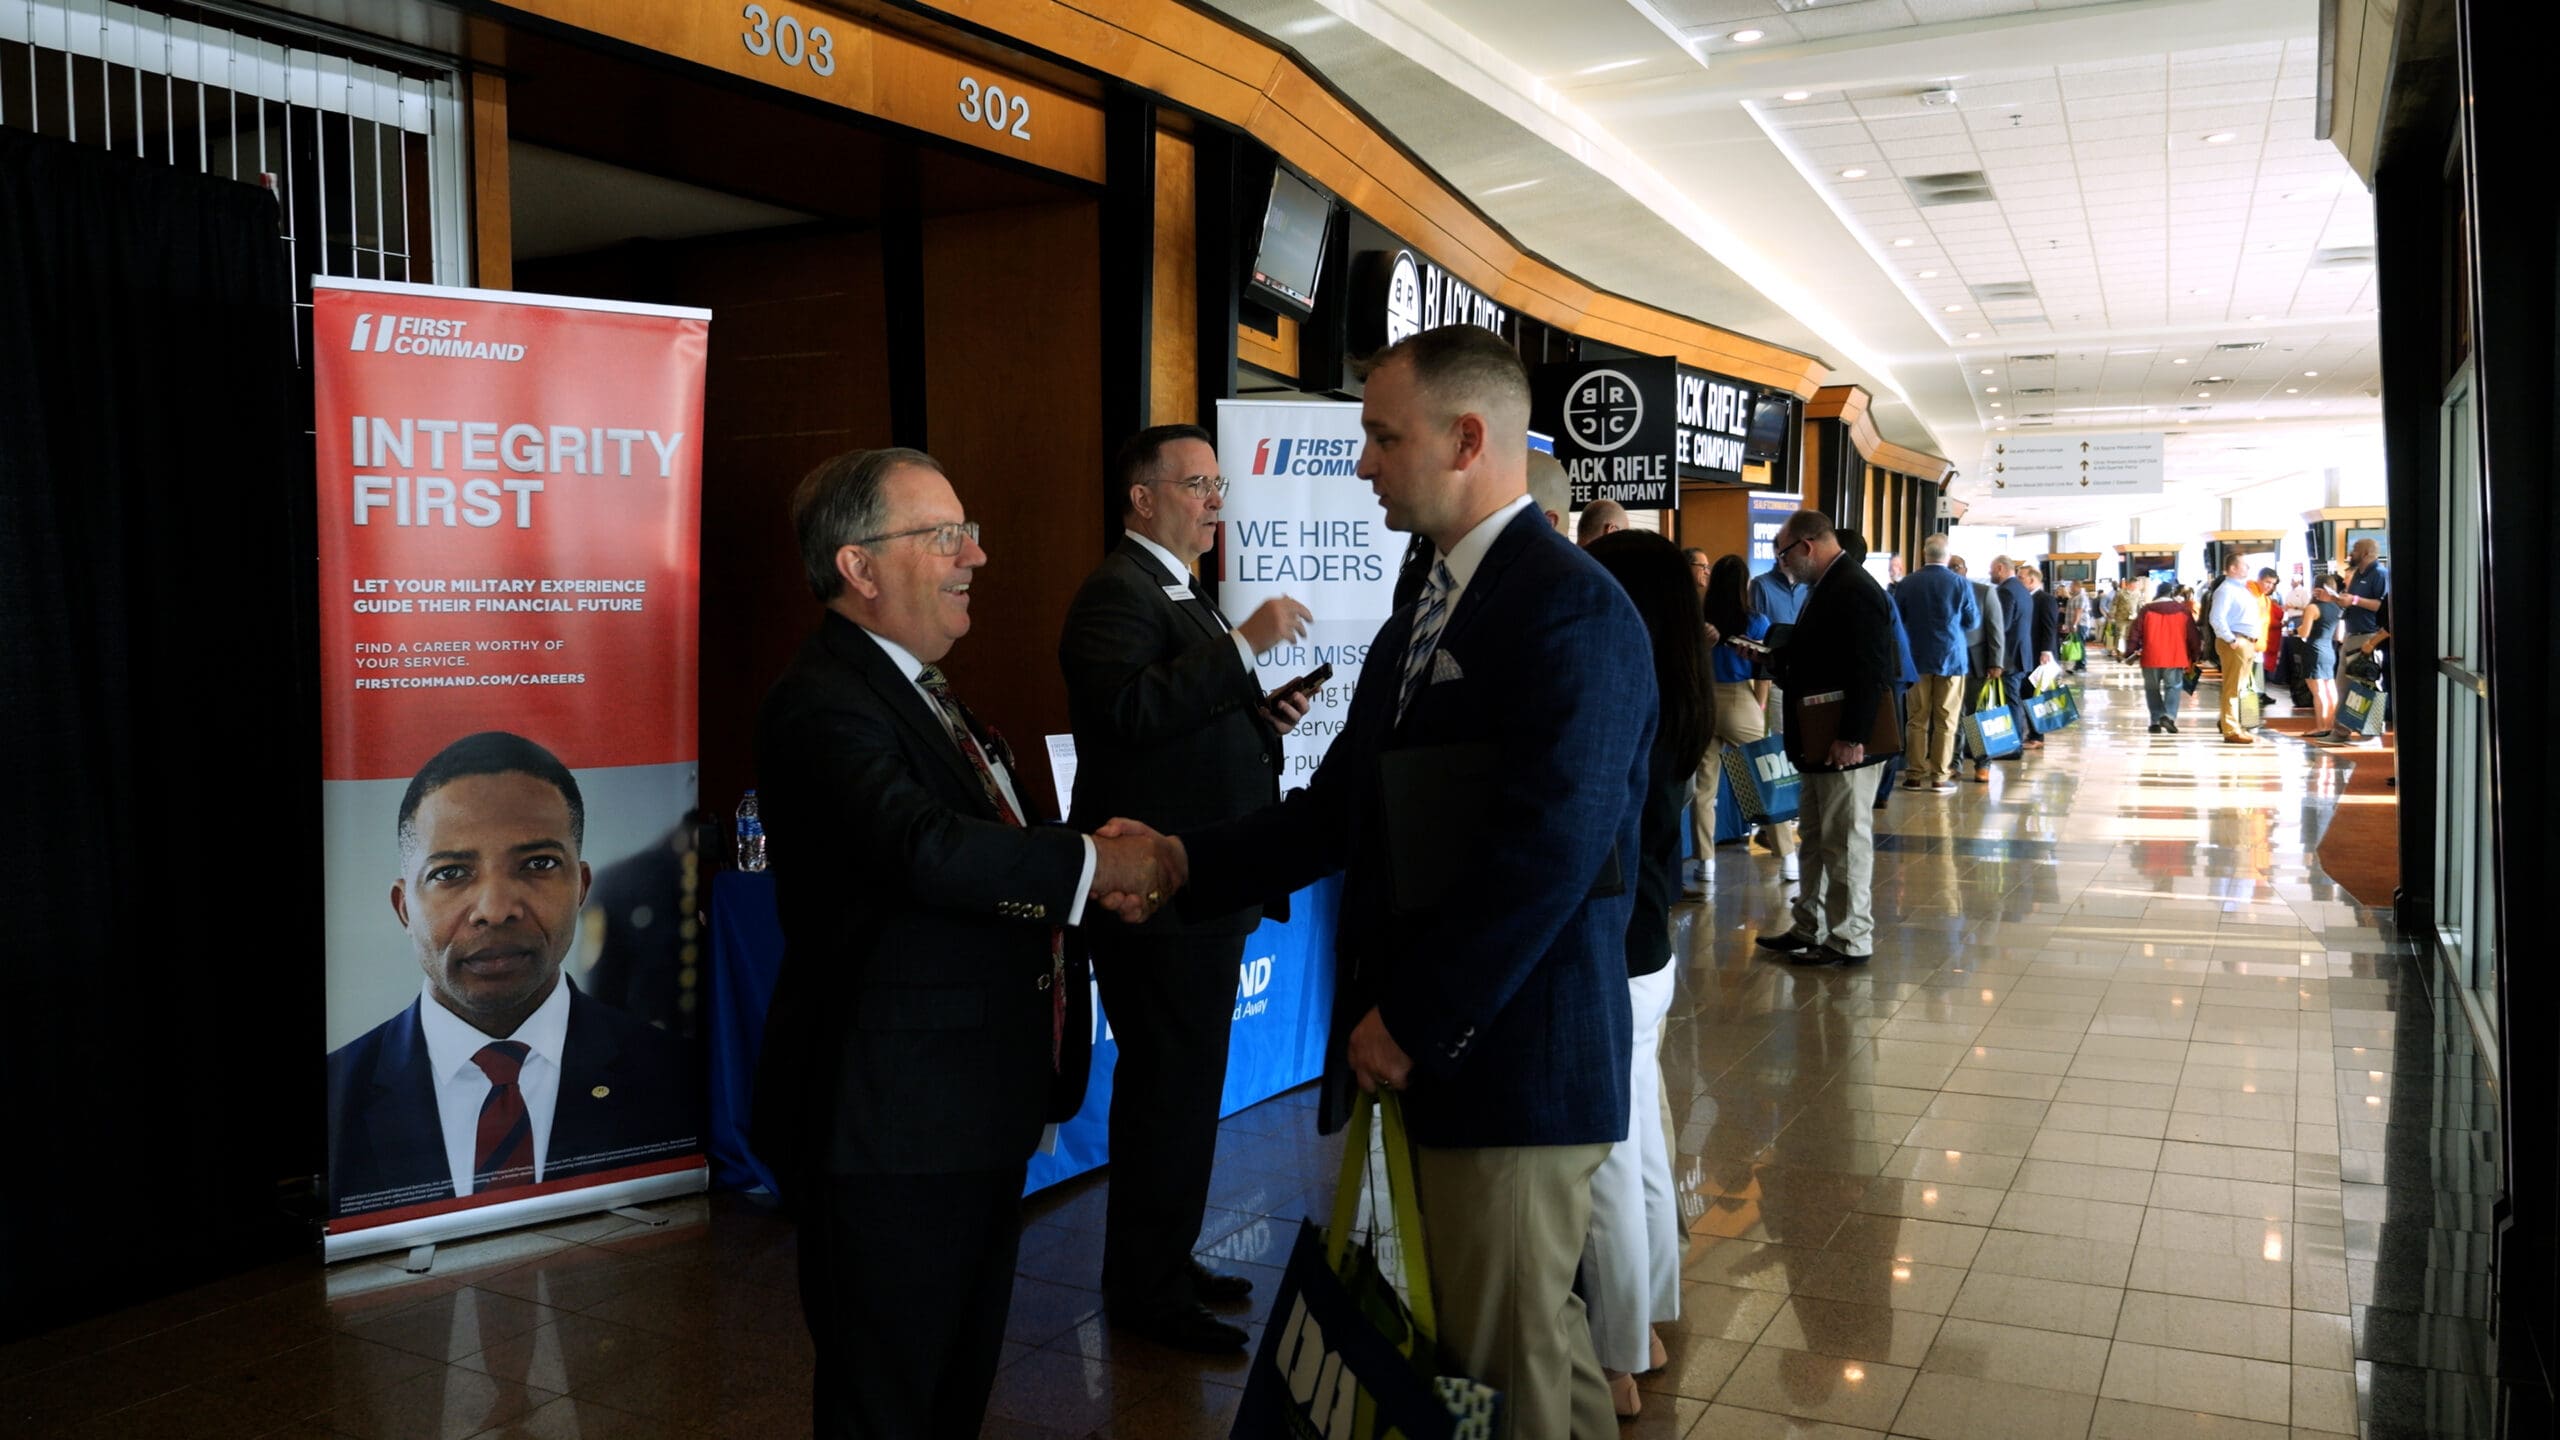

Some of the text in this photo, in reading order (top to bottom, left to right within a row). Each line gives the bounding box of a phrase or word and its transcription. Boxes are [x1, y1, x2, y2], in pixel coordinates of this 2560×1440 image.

[742, 4, 836, 77] 303
[958, 76, 1031, 141] 302
[399, 316, 467, 338] FIRST
[394, 335, 526, 362] COMMAND
[1706, 382, 1749, 437] RIFLE
[352, 416, 685, 478] INTEGRITY
[1295, 438, 1358, 457] FIRST
[1693, 433, 1745, 473] COMPANY
[1291, 458, 1360, 477] COMM
[1569, 454, 1667, 483] ACK RIFLE
[352, 475, 545, 529] FIRST
[1598, 482, 1667, 502] COMPANY
[1236, 520, 1370, 548] WE HIRE
[1239, 554, 1383, 583] LEADERS
[353, 578, 646, 594] LET YOUR MILITARY EXPERIENCE
[353, 598, 643, 614] GUIDE THEIR FINANCIAL FUTURE
[355, 639, 565, 654] FIND A CAREER WORTHY OF
[1255, 644, 1371, 668] OUR MISS
[355, 656, 470, 669] YOUR SERVICE.
[354, 673, 586, 690] FIRSTCOMMAND.COM/CAREERS
[1754, 749, 1800, 783] DA
[1236, 956, 1272, 1000] ND
